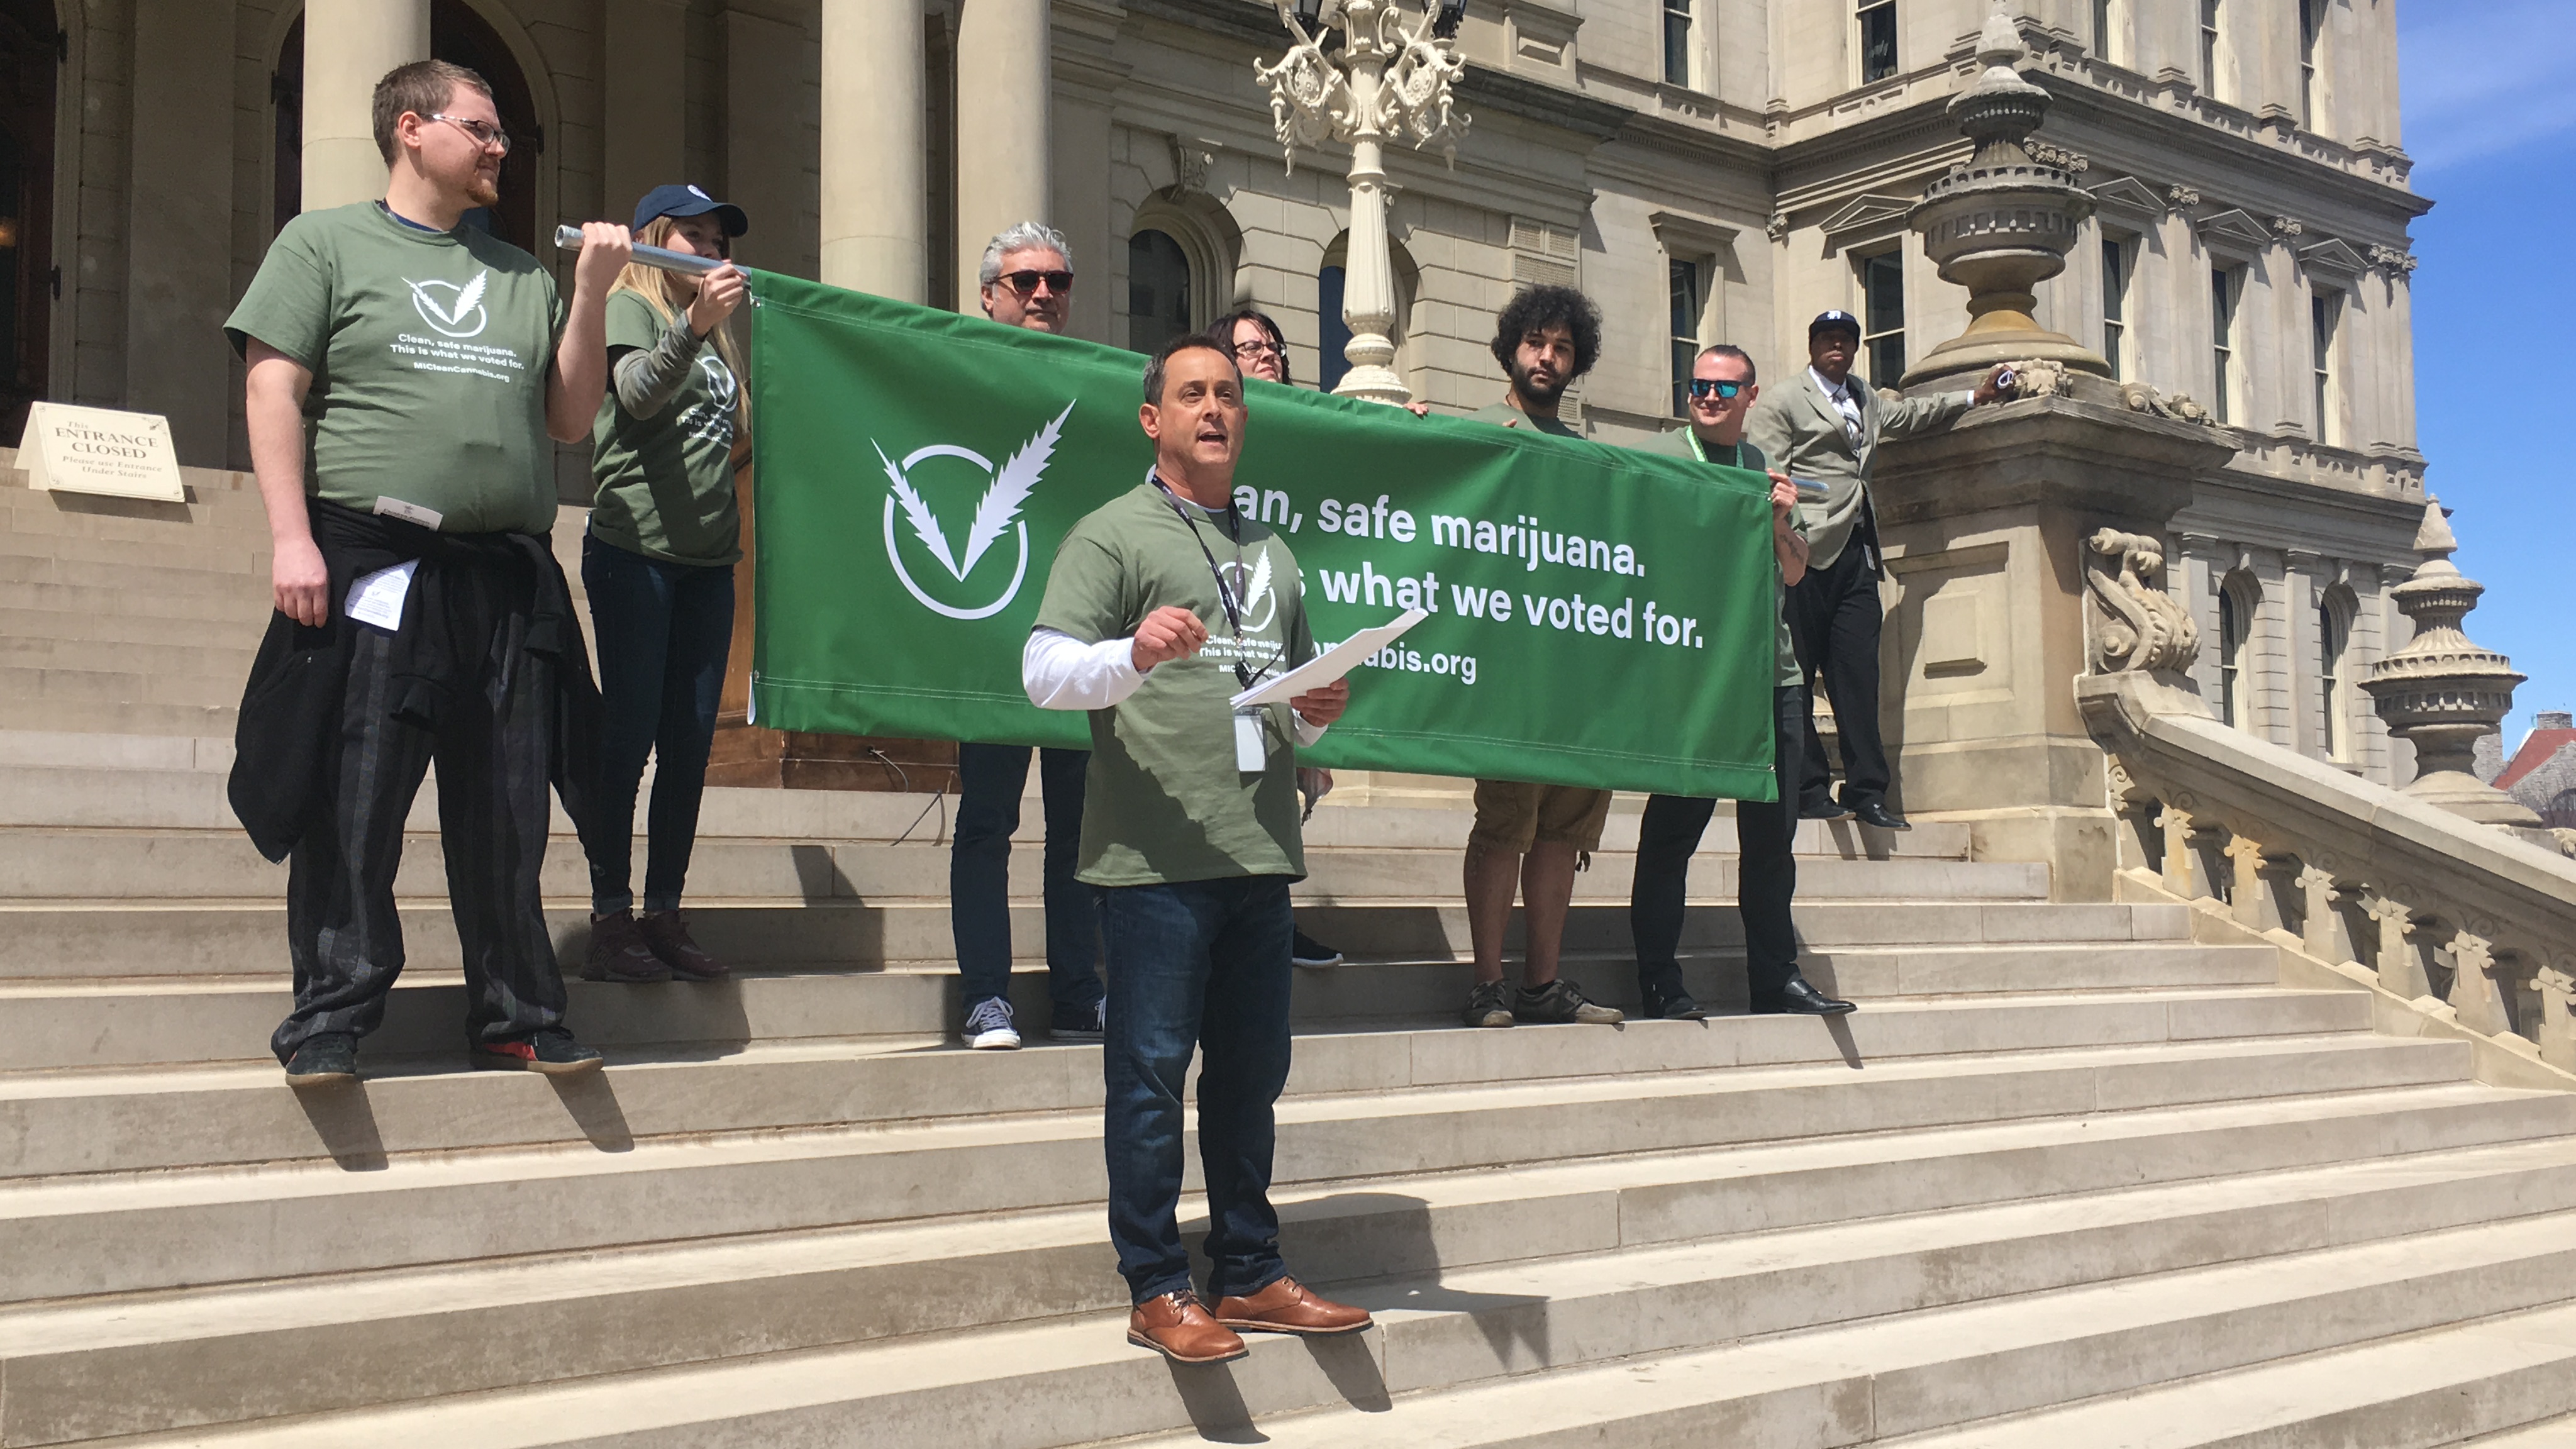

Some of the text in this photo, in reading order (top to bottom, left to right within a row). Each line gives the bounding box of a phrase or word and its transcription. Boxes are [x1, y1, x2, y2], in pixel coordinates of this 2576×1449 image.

[398, 333, 517, 357] Clean, safe marijuana.
[390, 344, 525, 370] This is what we voted for.
[67, 421, 89, 429] This
[55, 427, 158, 448] ENTRANCE
[72, 442, 147, 458] CLOSED
[62, 455, 95, 465] Please
[118, 461, 162, 472] Entrance
[82, 466, 147, 479] Under Stairs
[1318, 494, 1416, 542] safe
[1431, 514, 1645, 577] marijuana.
[1319, 562, 1439, 612] what
[1451, 584, 1511, 622] we
[1523, 594, 1633, 639] voted
[1643, 601, 1703, 648] for.
[1199, 647, 1221, 657] This
[1223, 647, 1233, 657] is
